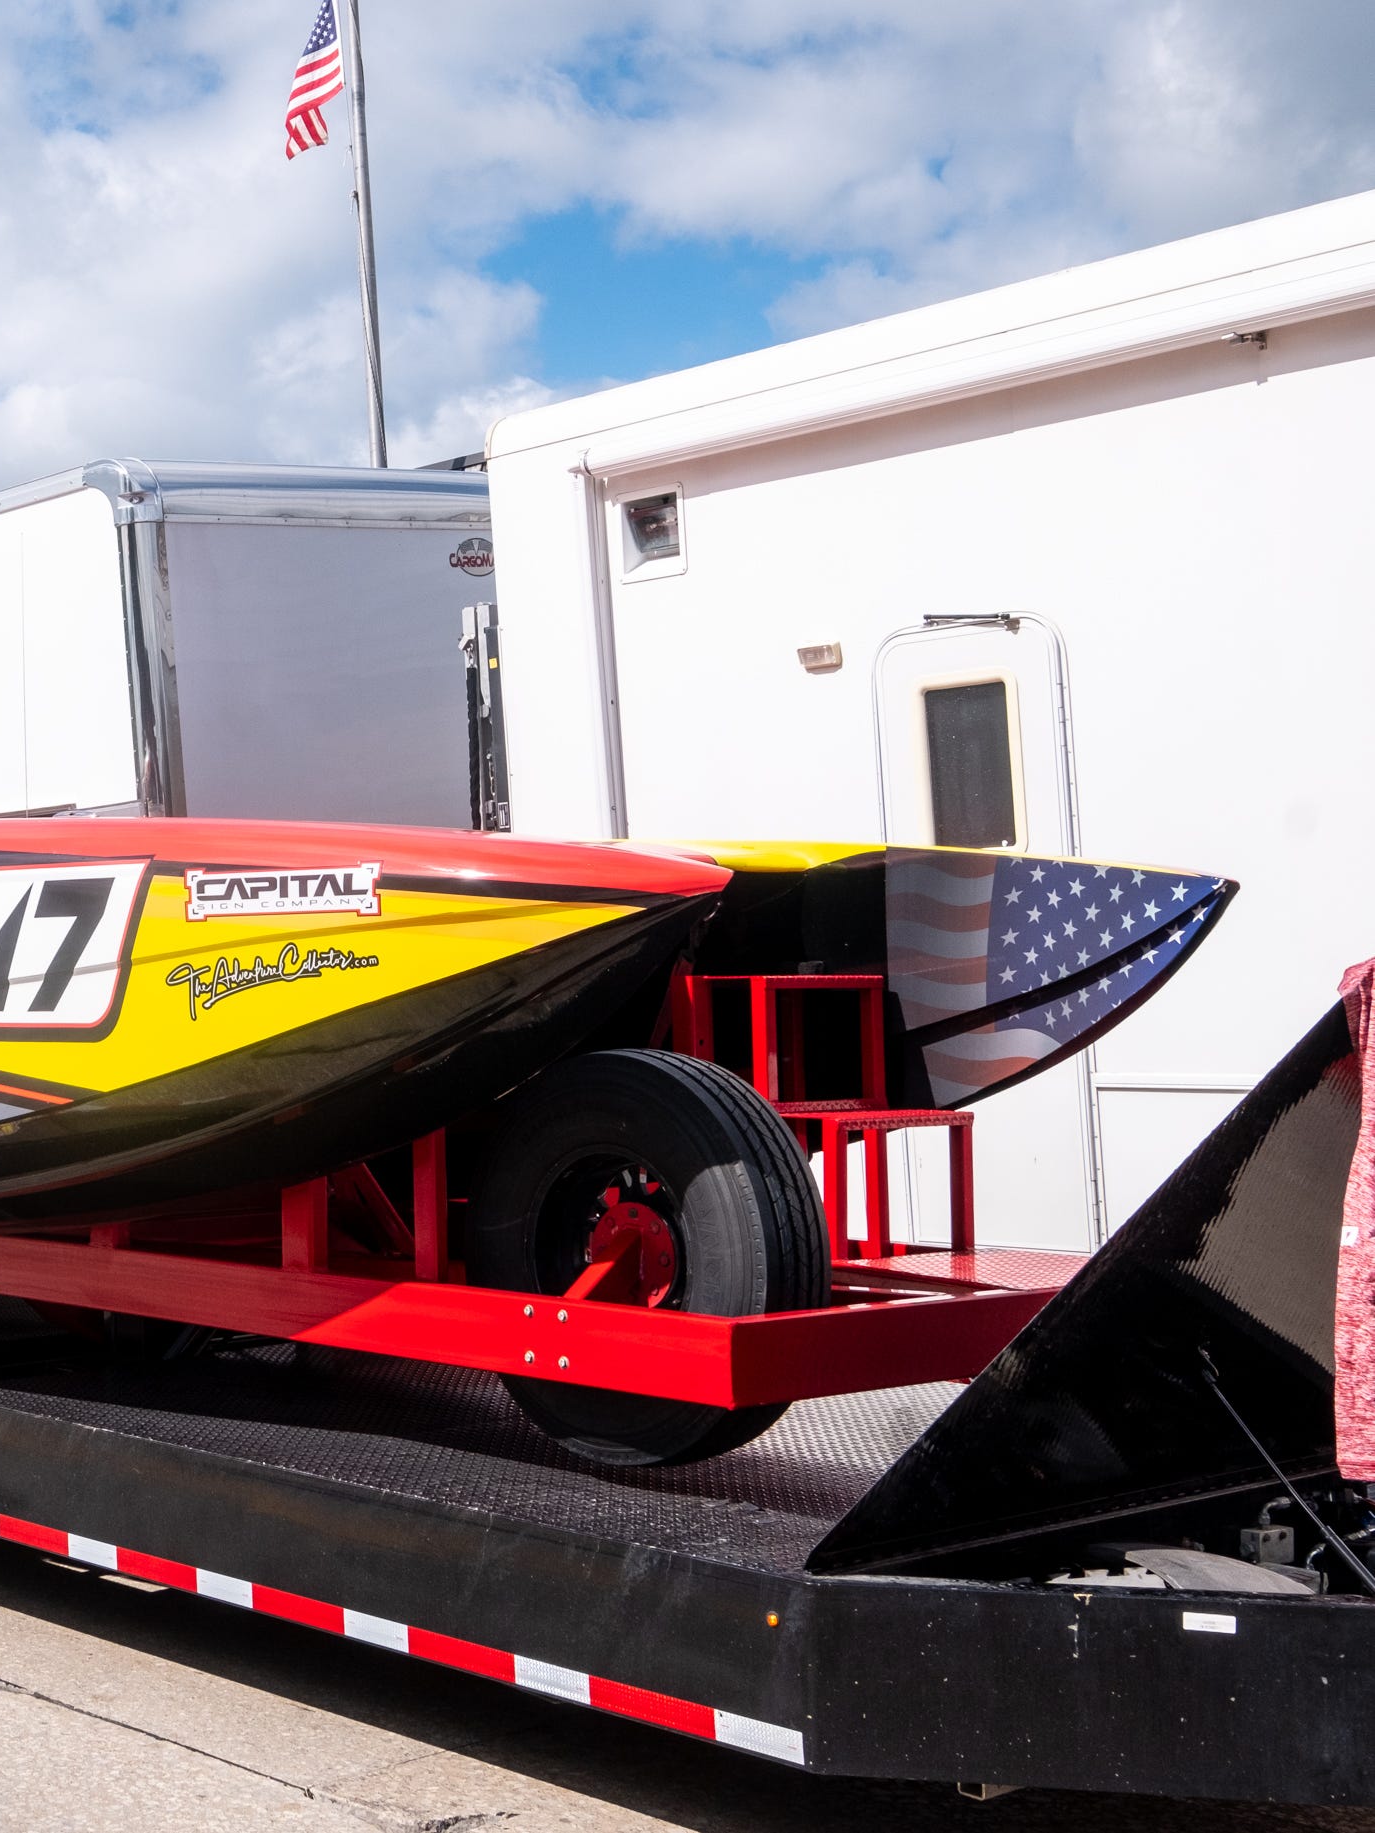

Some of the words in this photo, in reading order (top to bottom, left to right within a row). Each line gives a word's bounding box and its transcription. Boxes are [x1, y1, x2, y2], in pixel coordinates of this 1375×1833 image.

[196, 873, 369, 901] CAPITAL
[197, 902, 244, 911] SIGN
[261, 898, 368, 908] COMPANY
